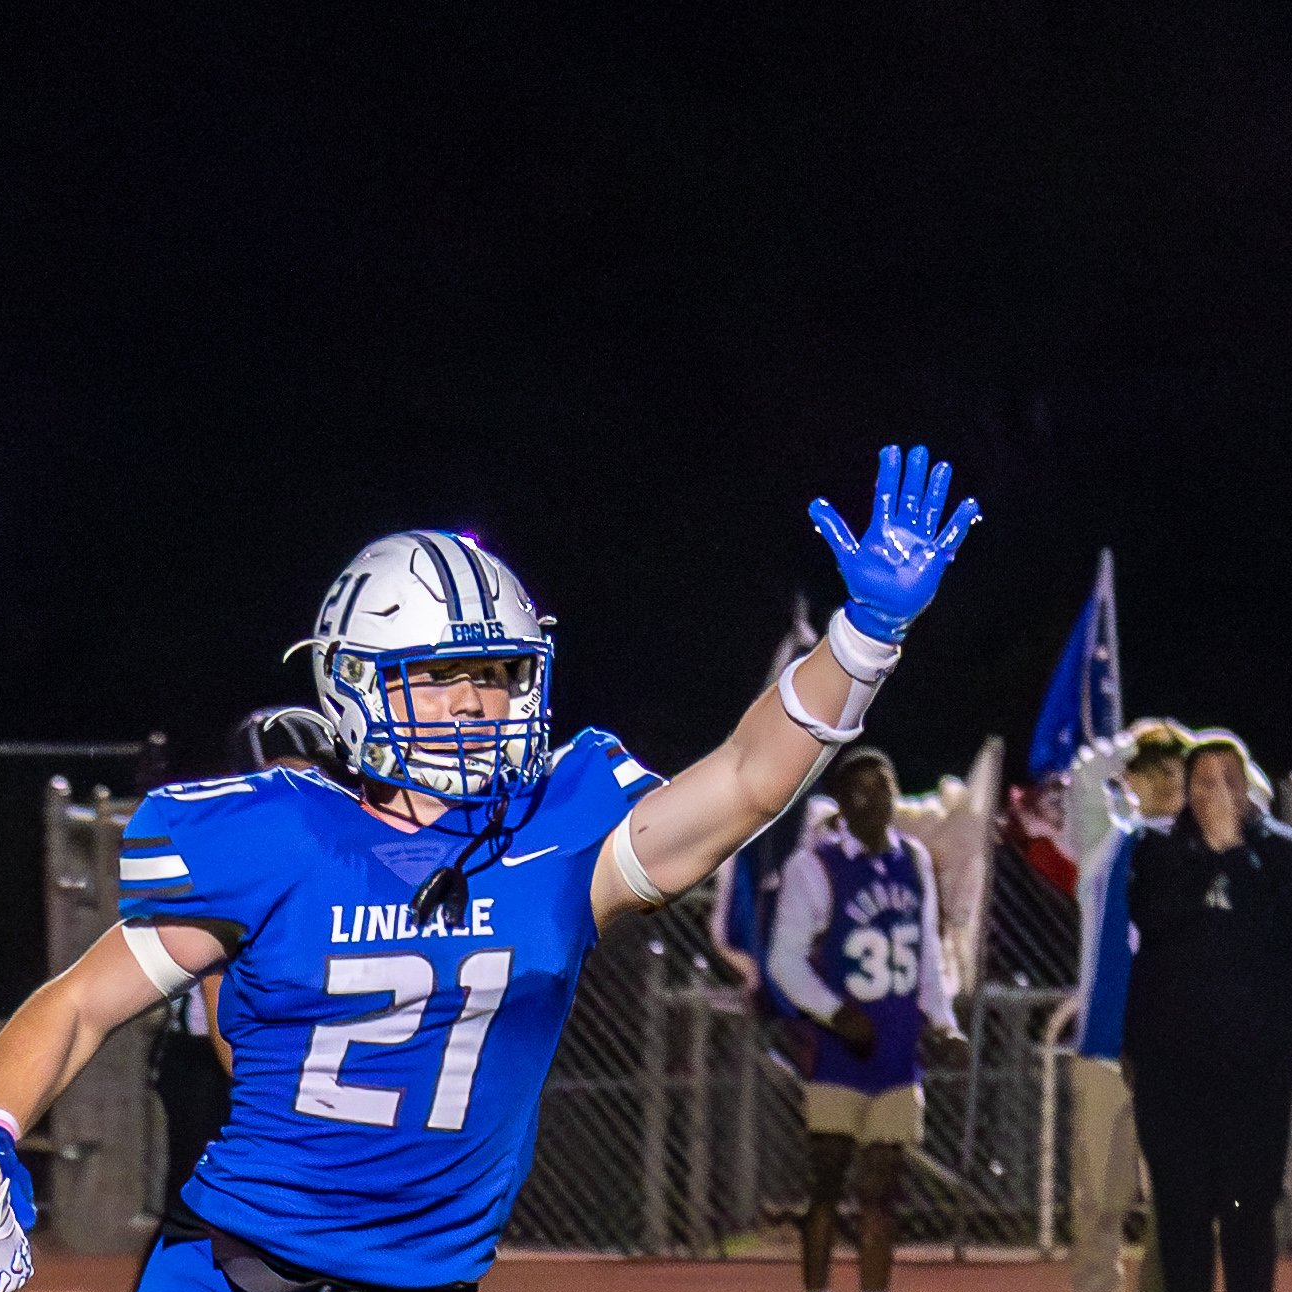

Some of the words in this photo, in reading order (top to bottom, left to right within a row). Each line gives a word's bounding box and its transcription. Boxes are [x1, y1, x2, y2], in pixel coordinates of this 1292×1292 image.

[318, 572, 372, 636] 21
[843, 923, 920, 1001] 35
[294, 946, 515, 1132] 21
